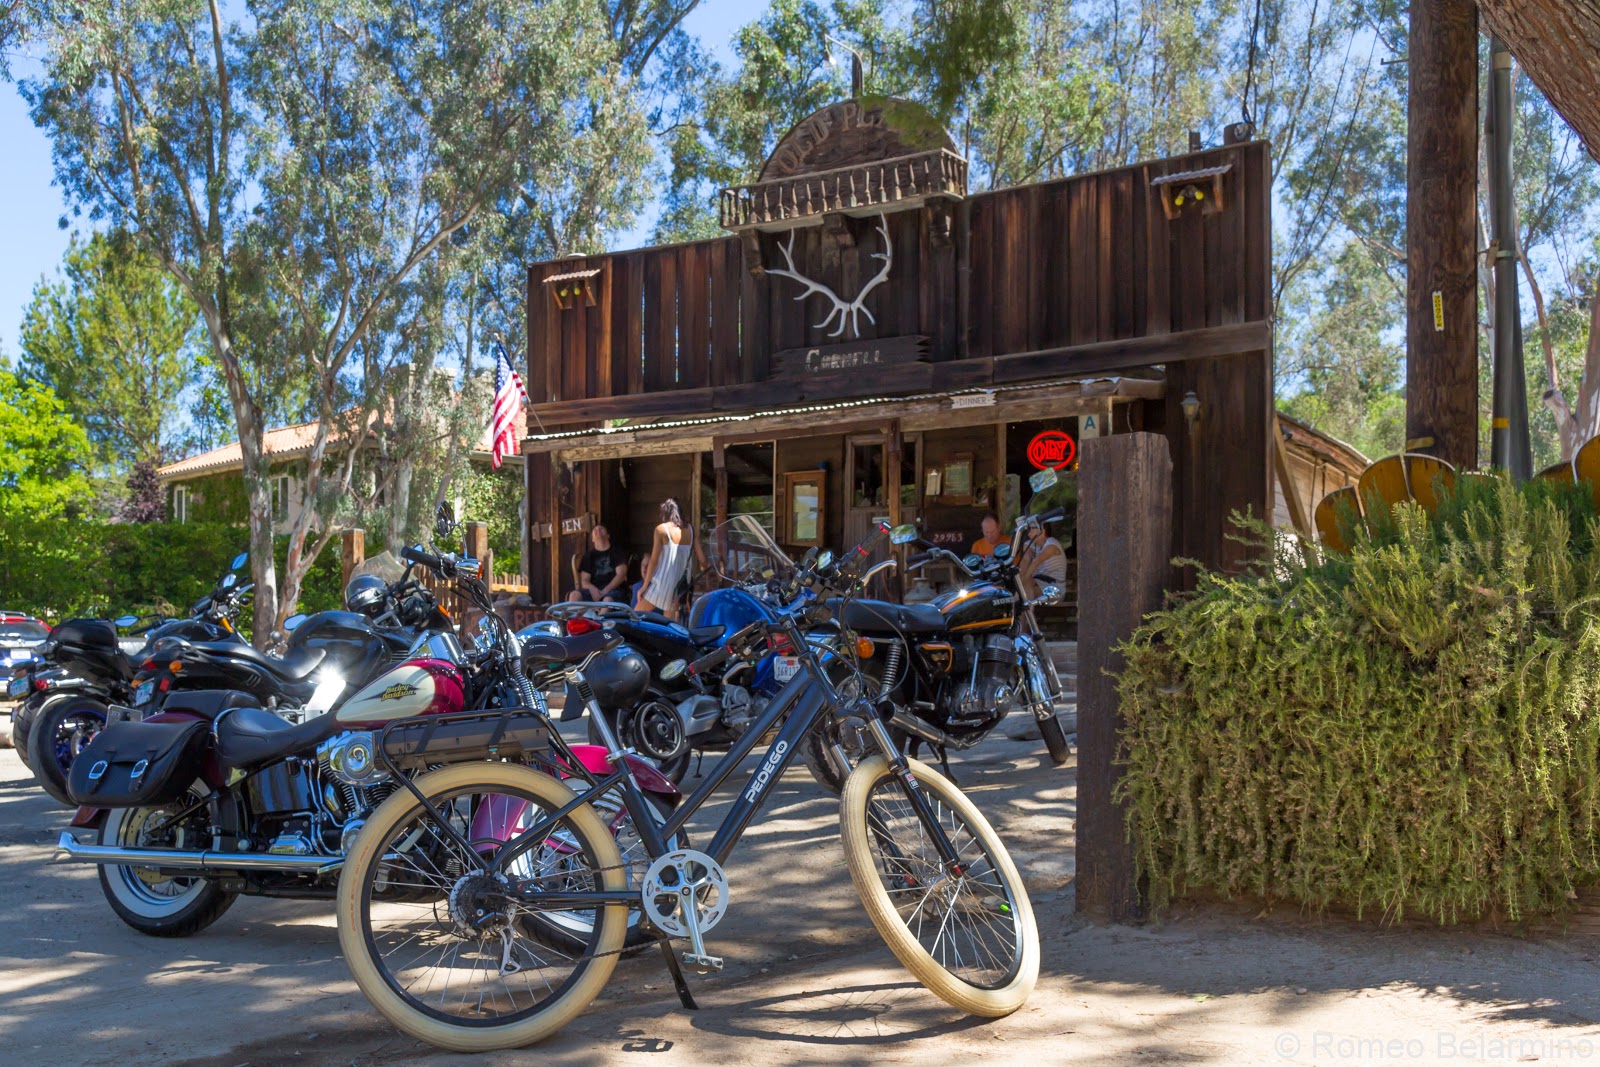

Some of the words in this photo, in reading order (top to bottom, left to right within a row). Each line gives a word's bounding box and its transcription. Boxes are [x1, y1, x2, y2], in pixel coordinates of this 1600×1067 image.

[959, 397, 987, 406] DINNER
[1084, 415, 1096, 430] A
[1033, 440, 1069, 463] OLY
[549, 518, 581, 534] EN
[745, 740, 788, 803] PEDEGO
